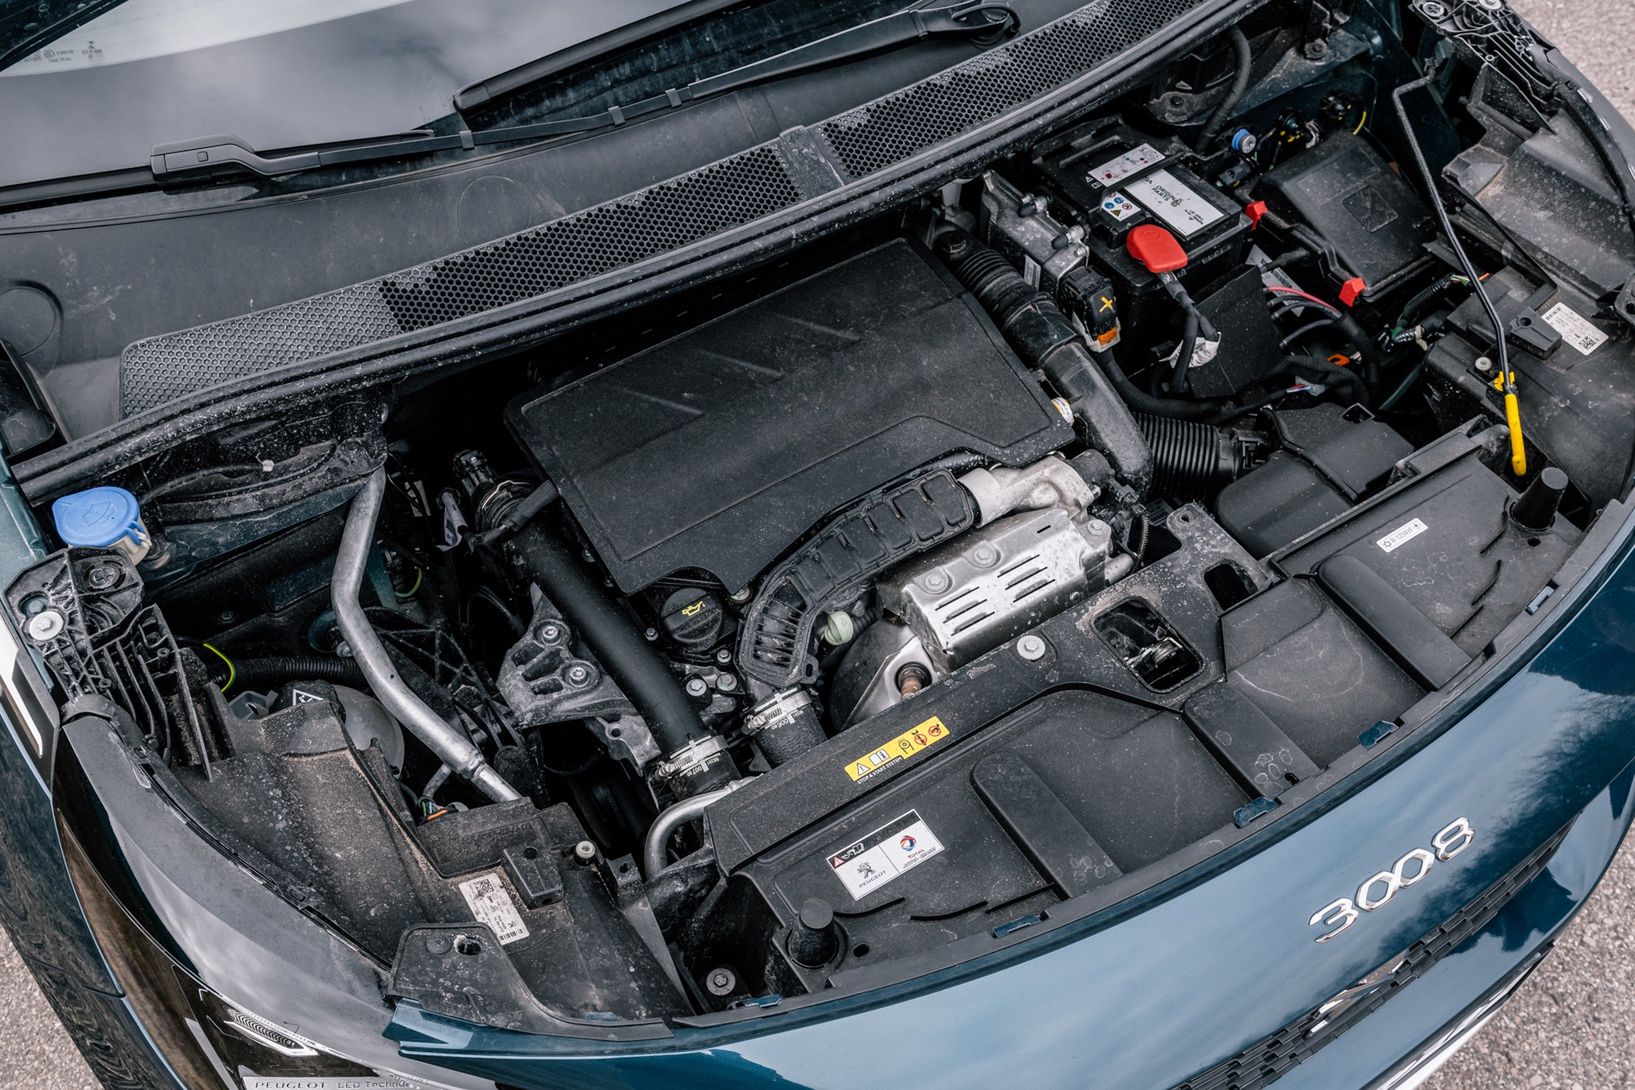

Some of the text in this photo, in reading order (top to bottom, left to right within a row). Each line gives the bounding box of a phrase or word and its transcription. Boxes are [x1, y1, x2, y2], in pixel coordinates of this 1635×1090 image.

[1151, 187, 1169, 201] PARTS
[1156, 185, 1183, 206] ORIGINAL
[886, 756, 903, 768] SYSTEM
[907, 848, 926, 859] TOTAL
[858, 870, 887, 888] PEUGEOT
[1308, 815, 1476, 944] 3008
[255, 1081, 327, 1089] PEUGEOT
[337, 1081, 361, 1089] LED
